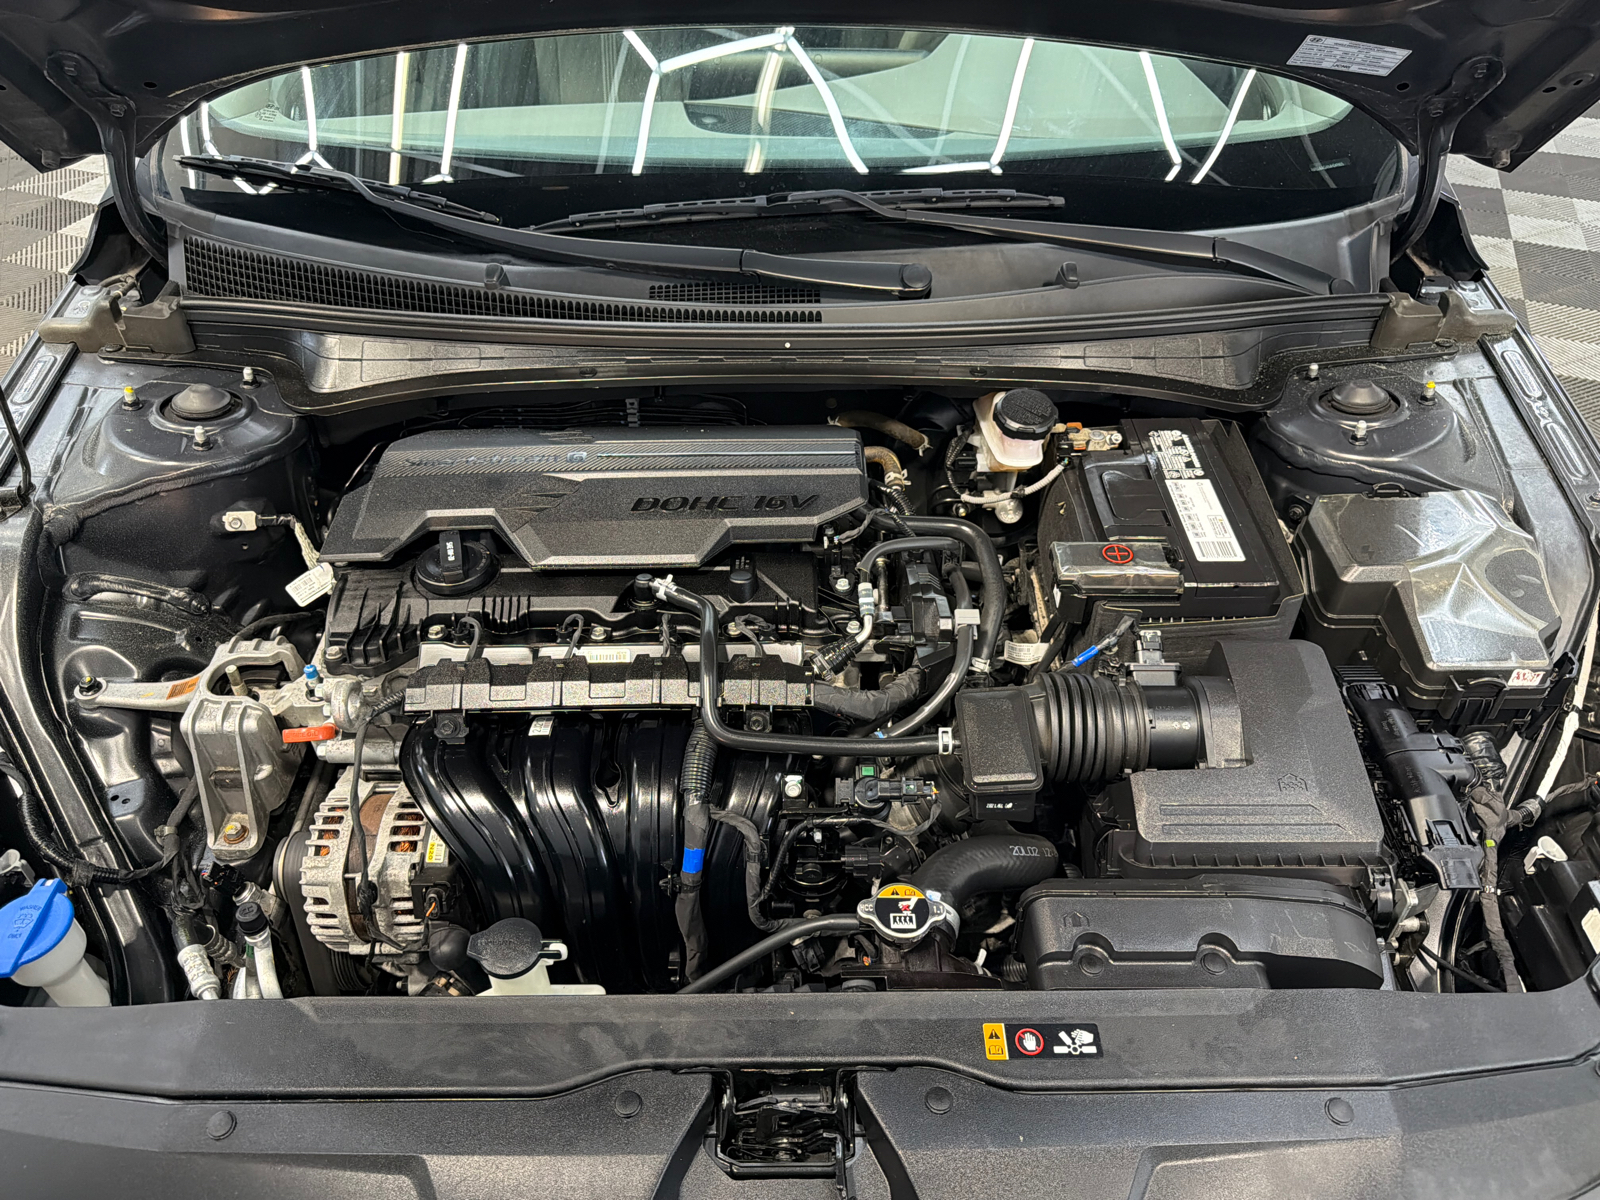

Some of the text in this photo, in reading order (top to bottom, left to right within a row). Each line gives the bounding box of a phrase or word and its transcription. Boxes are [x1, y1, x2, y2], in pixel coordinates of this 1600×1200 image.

[631, 494, 820, 513] DOHC 16V
[859, 904, 944, 914] HCC 1.1
